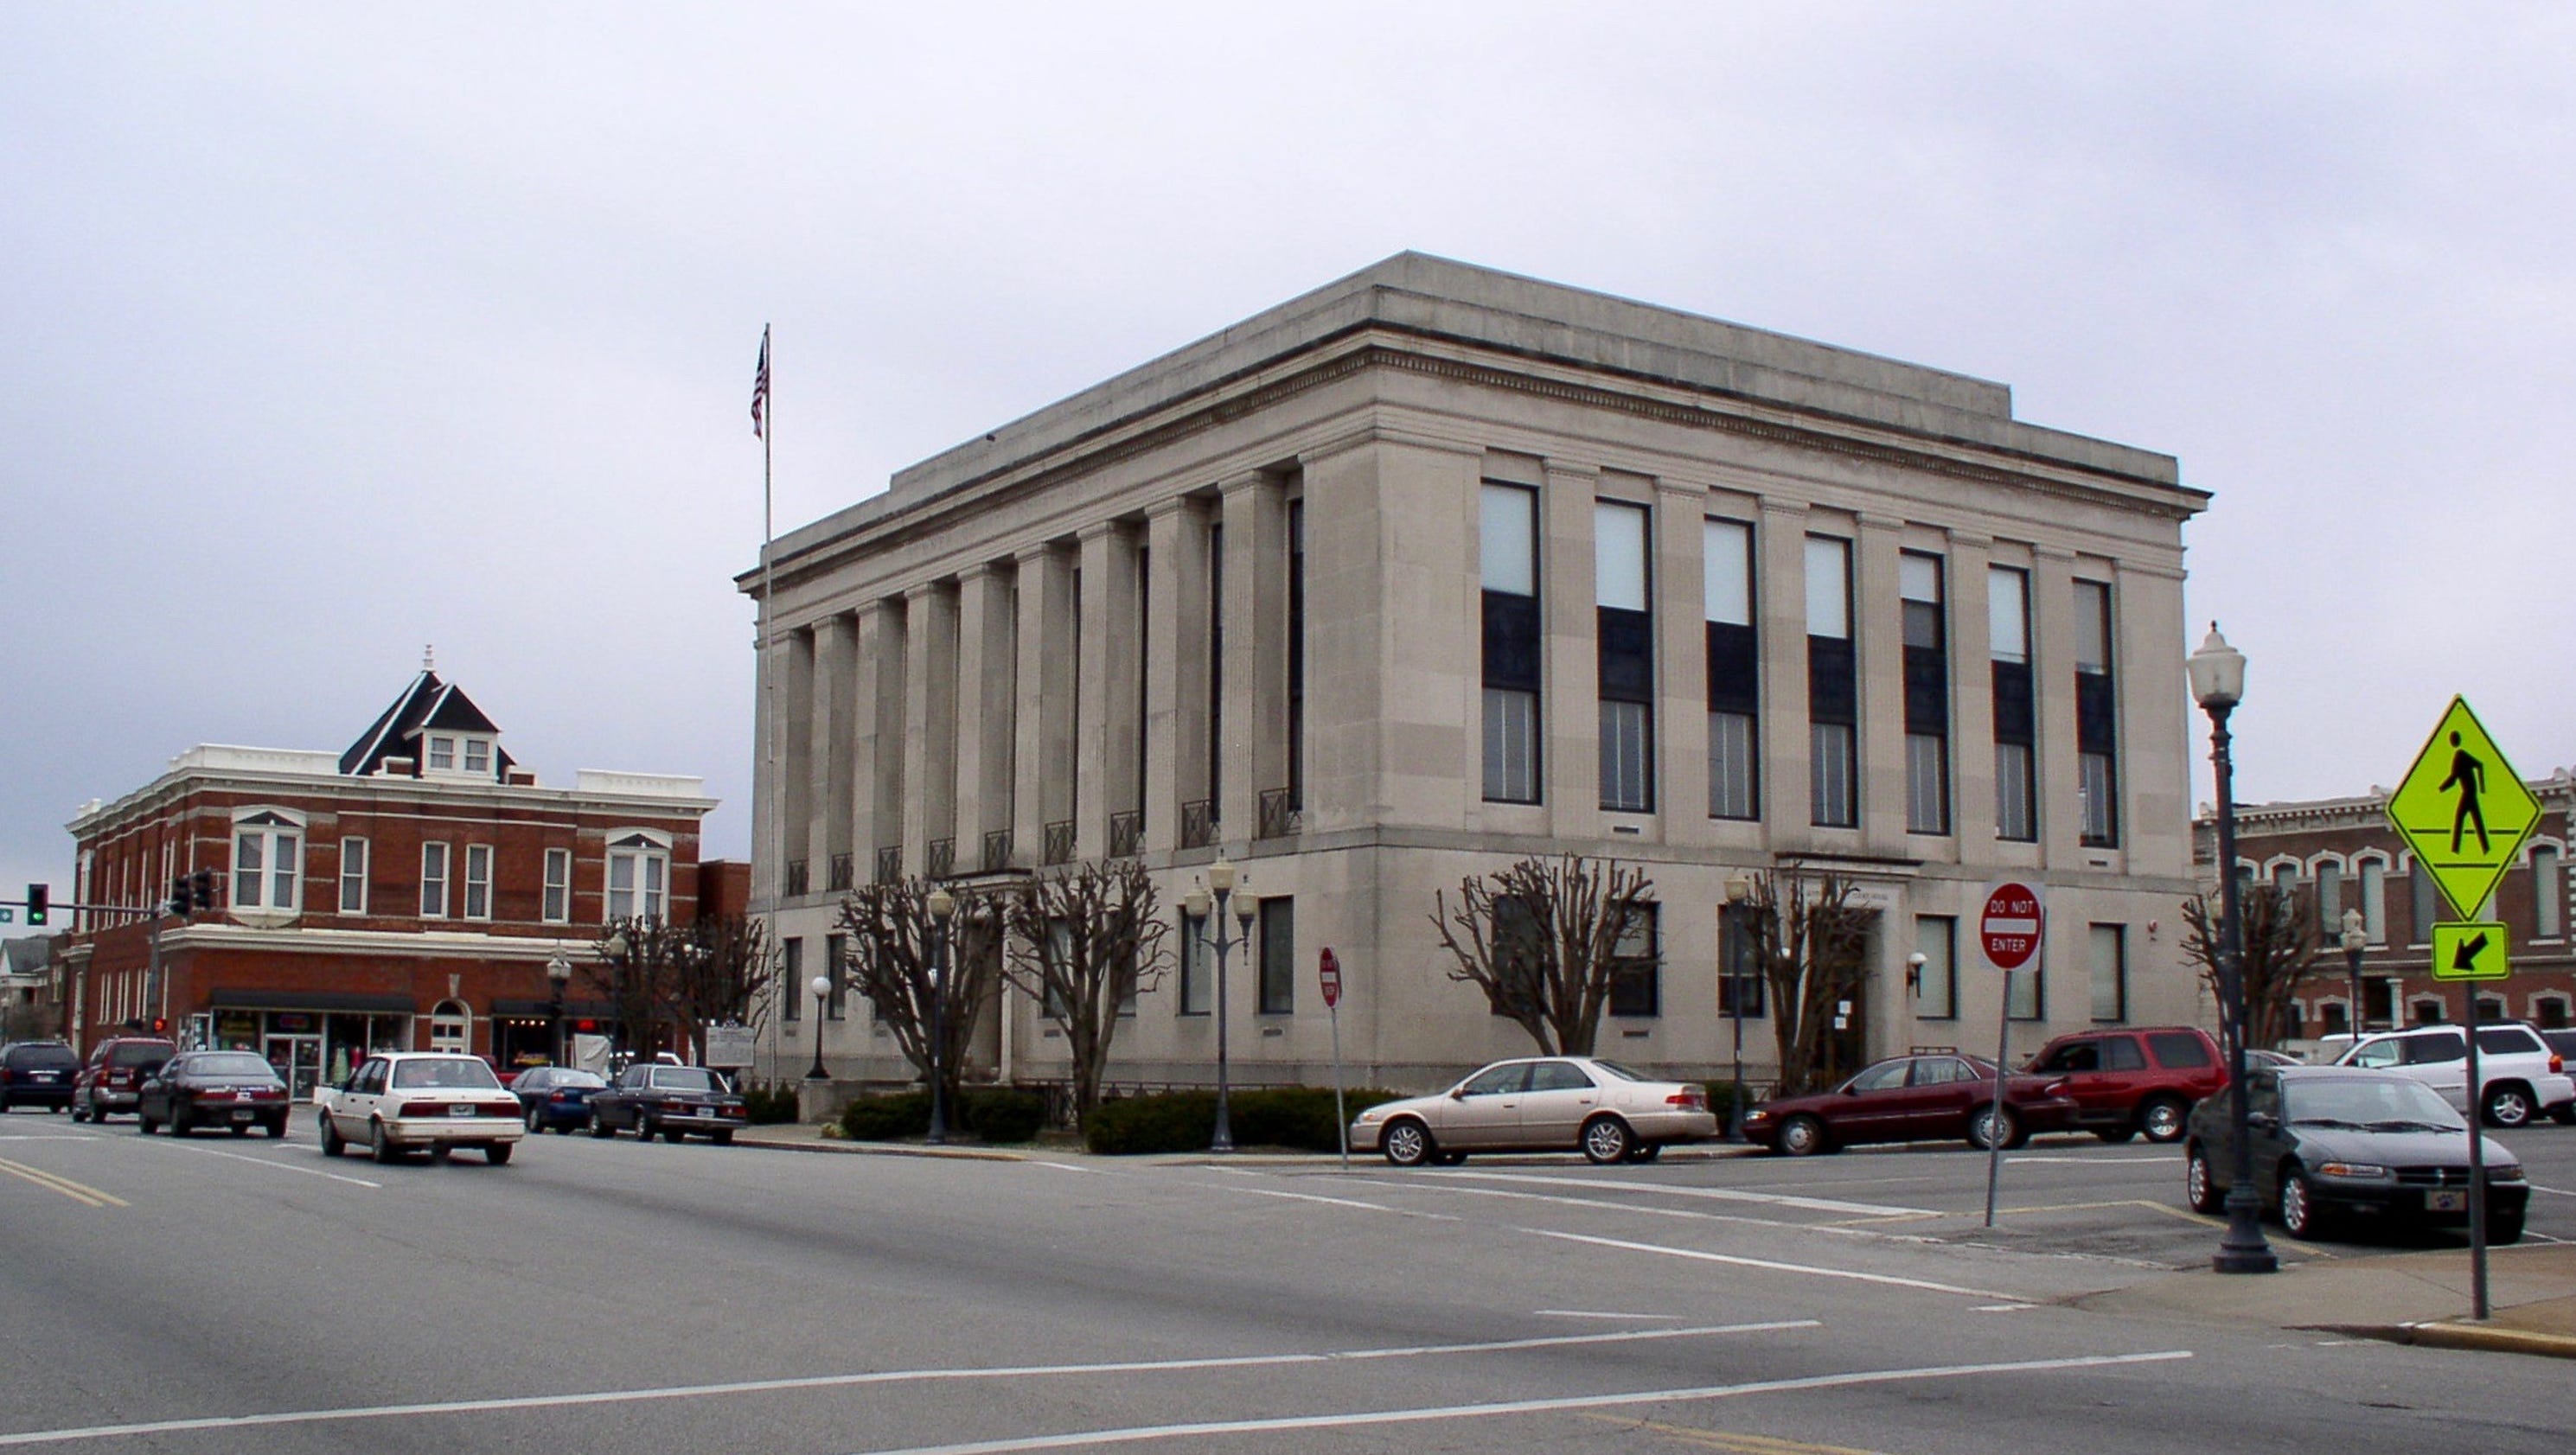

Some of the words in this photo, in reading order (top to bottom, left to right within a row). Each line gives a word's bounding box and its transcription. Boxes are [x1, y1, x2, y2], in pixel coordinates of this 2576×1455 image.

[1991, 900, 2005, 913] DO
[2011, 901, 2033, 913] NOT
[1992, 938, 2025, 952] ENTER
